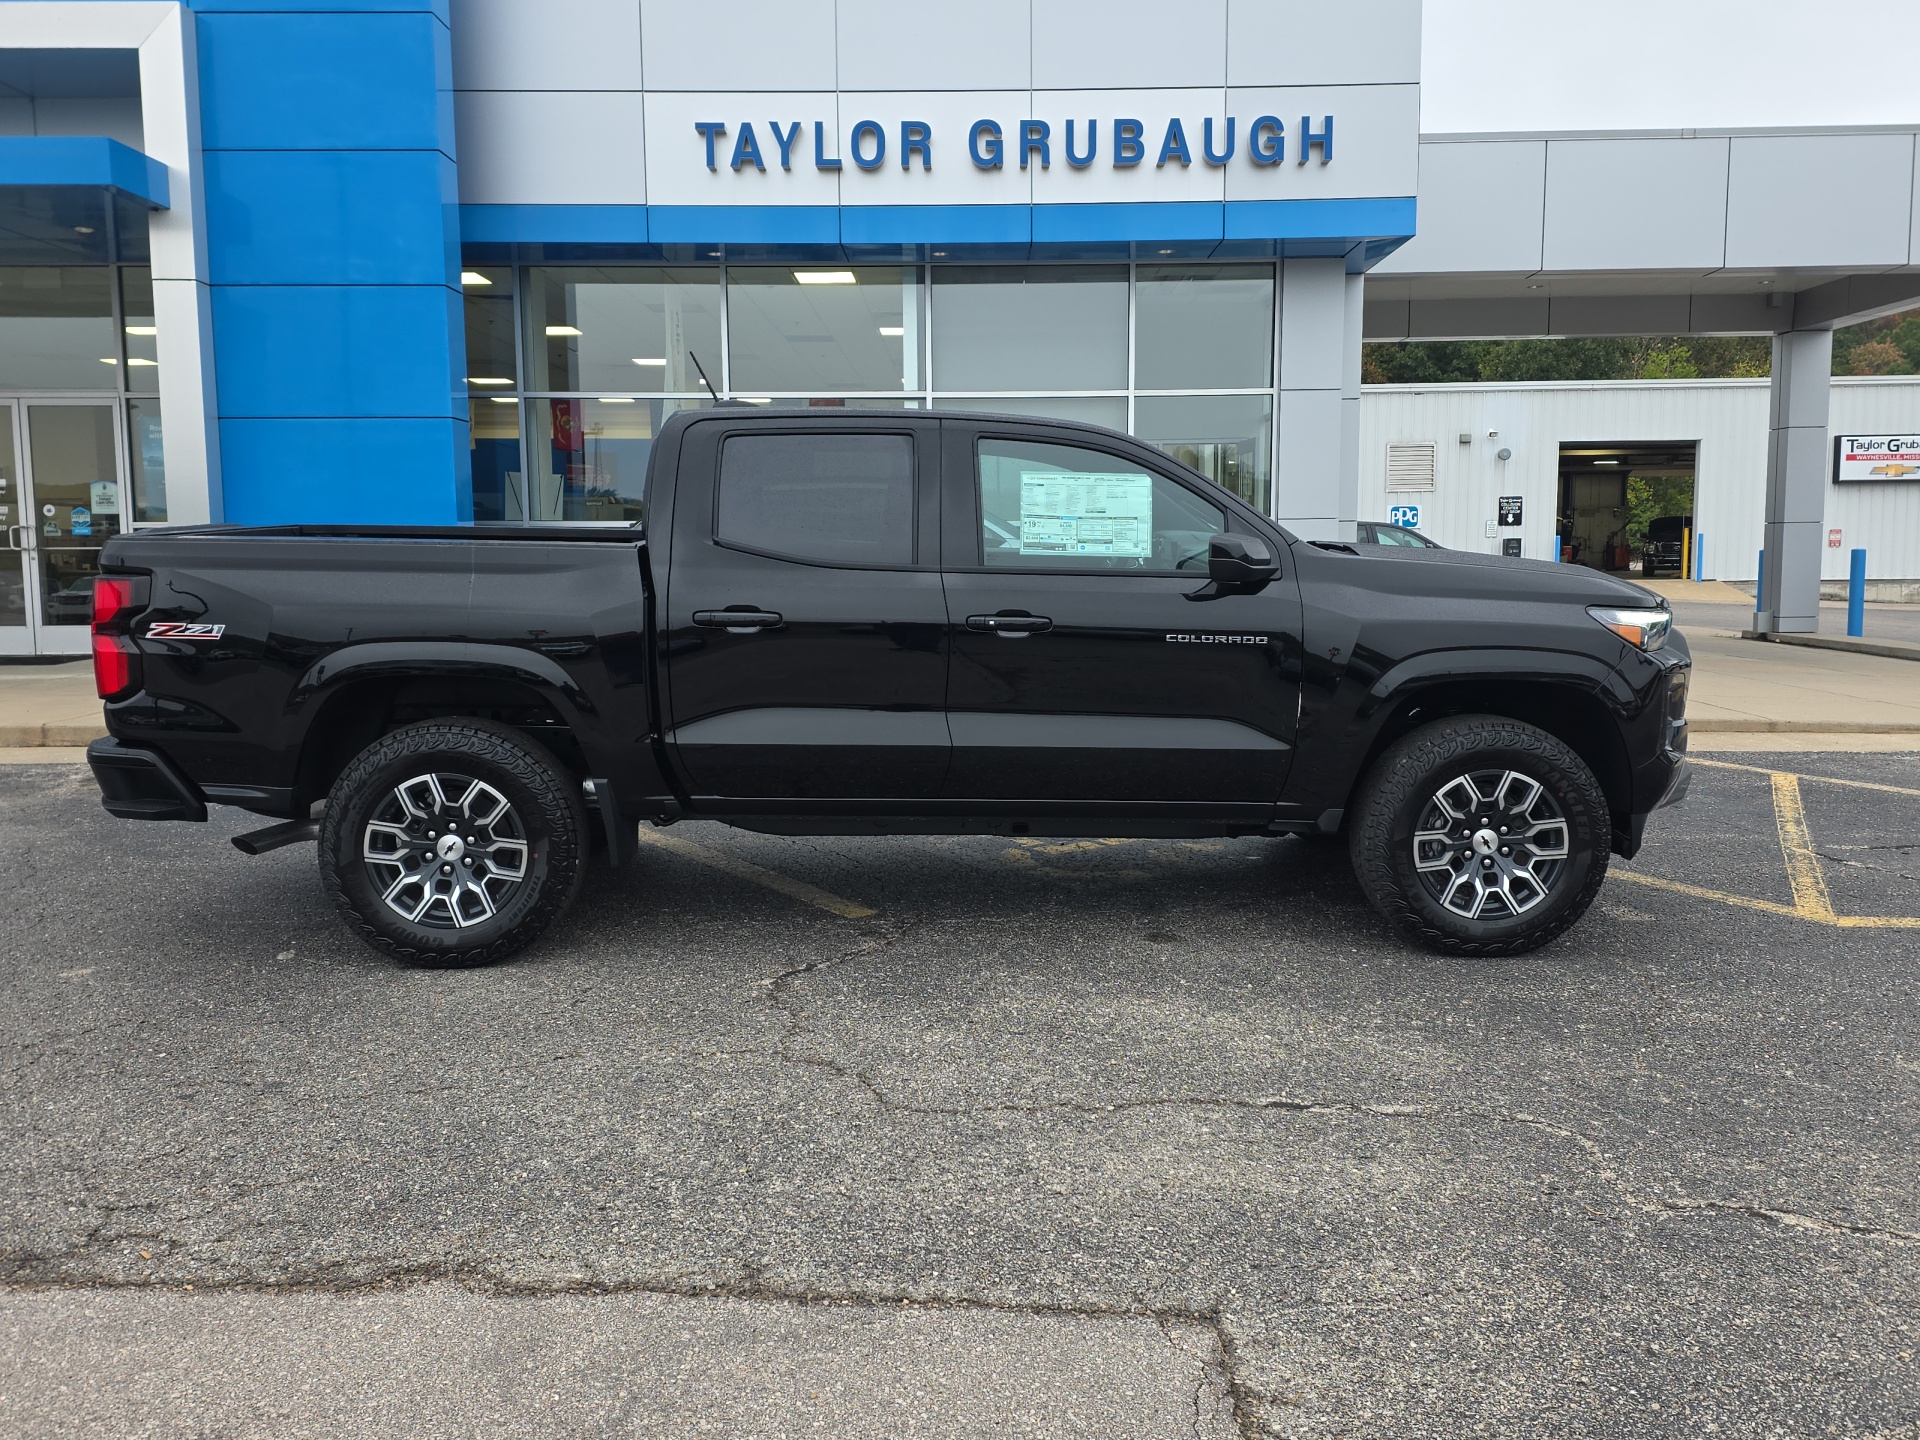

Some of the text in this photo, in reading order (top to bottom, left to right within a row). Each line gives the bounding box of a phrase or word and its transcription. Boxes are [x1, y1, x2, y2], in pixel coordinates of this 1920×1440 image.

[694, 115, 1333, 172] TAYLOR GRUBAUGH
[1846, 439, 1885, 453] Taylor
[1027, 520, 1037, 528] 19
[1391, 507, 1418, 526] PPG
[145, 622, 226, 640] Z71
[1165, 634, 1268, 644] COLORADO
[508, 875, 541, 924] TERRITORY
